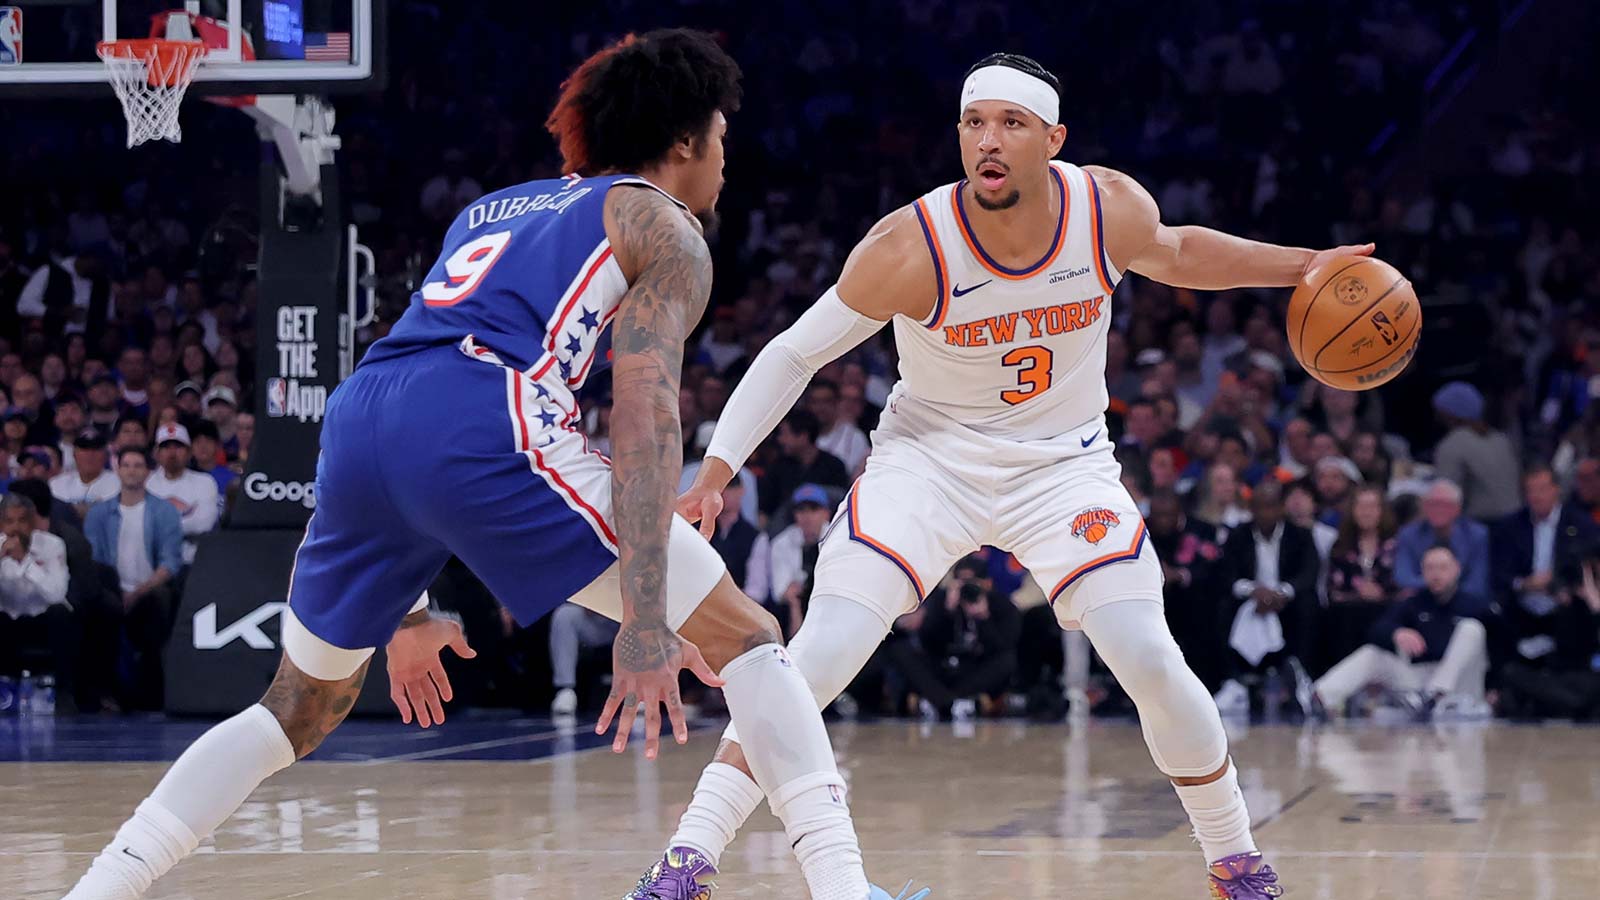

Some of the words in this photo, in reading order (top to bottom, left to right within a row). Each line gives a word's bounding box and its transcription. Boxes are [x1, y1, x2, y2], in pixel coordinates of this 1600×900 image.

[422, 230, 511, 308] 9
[1066, 266, 1090, 278] dhabi
[277, 306, 317, 342] GET
[944, 314, 1019, 347] NEW
[1022, 295, 1104, 338] YORK
[278, 343, 317, 378] THE
[1000, 345, 1053, 406] 3
[287, 379, 326, 423] App
[244, 472, 317, 508] Goog
[1071, 508, 1120, 537] KNICKS
